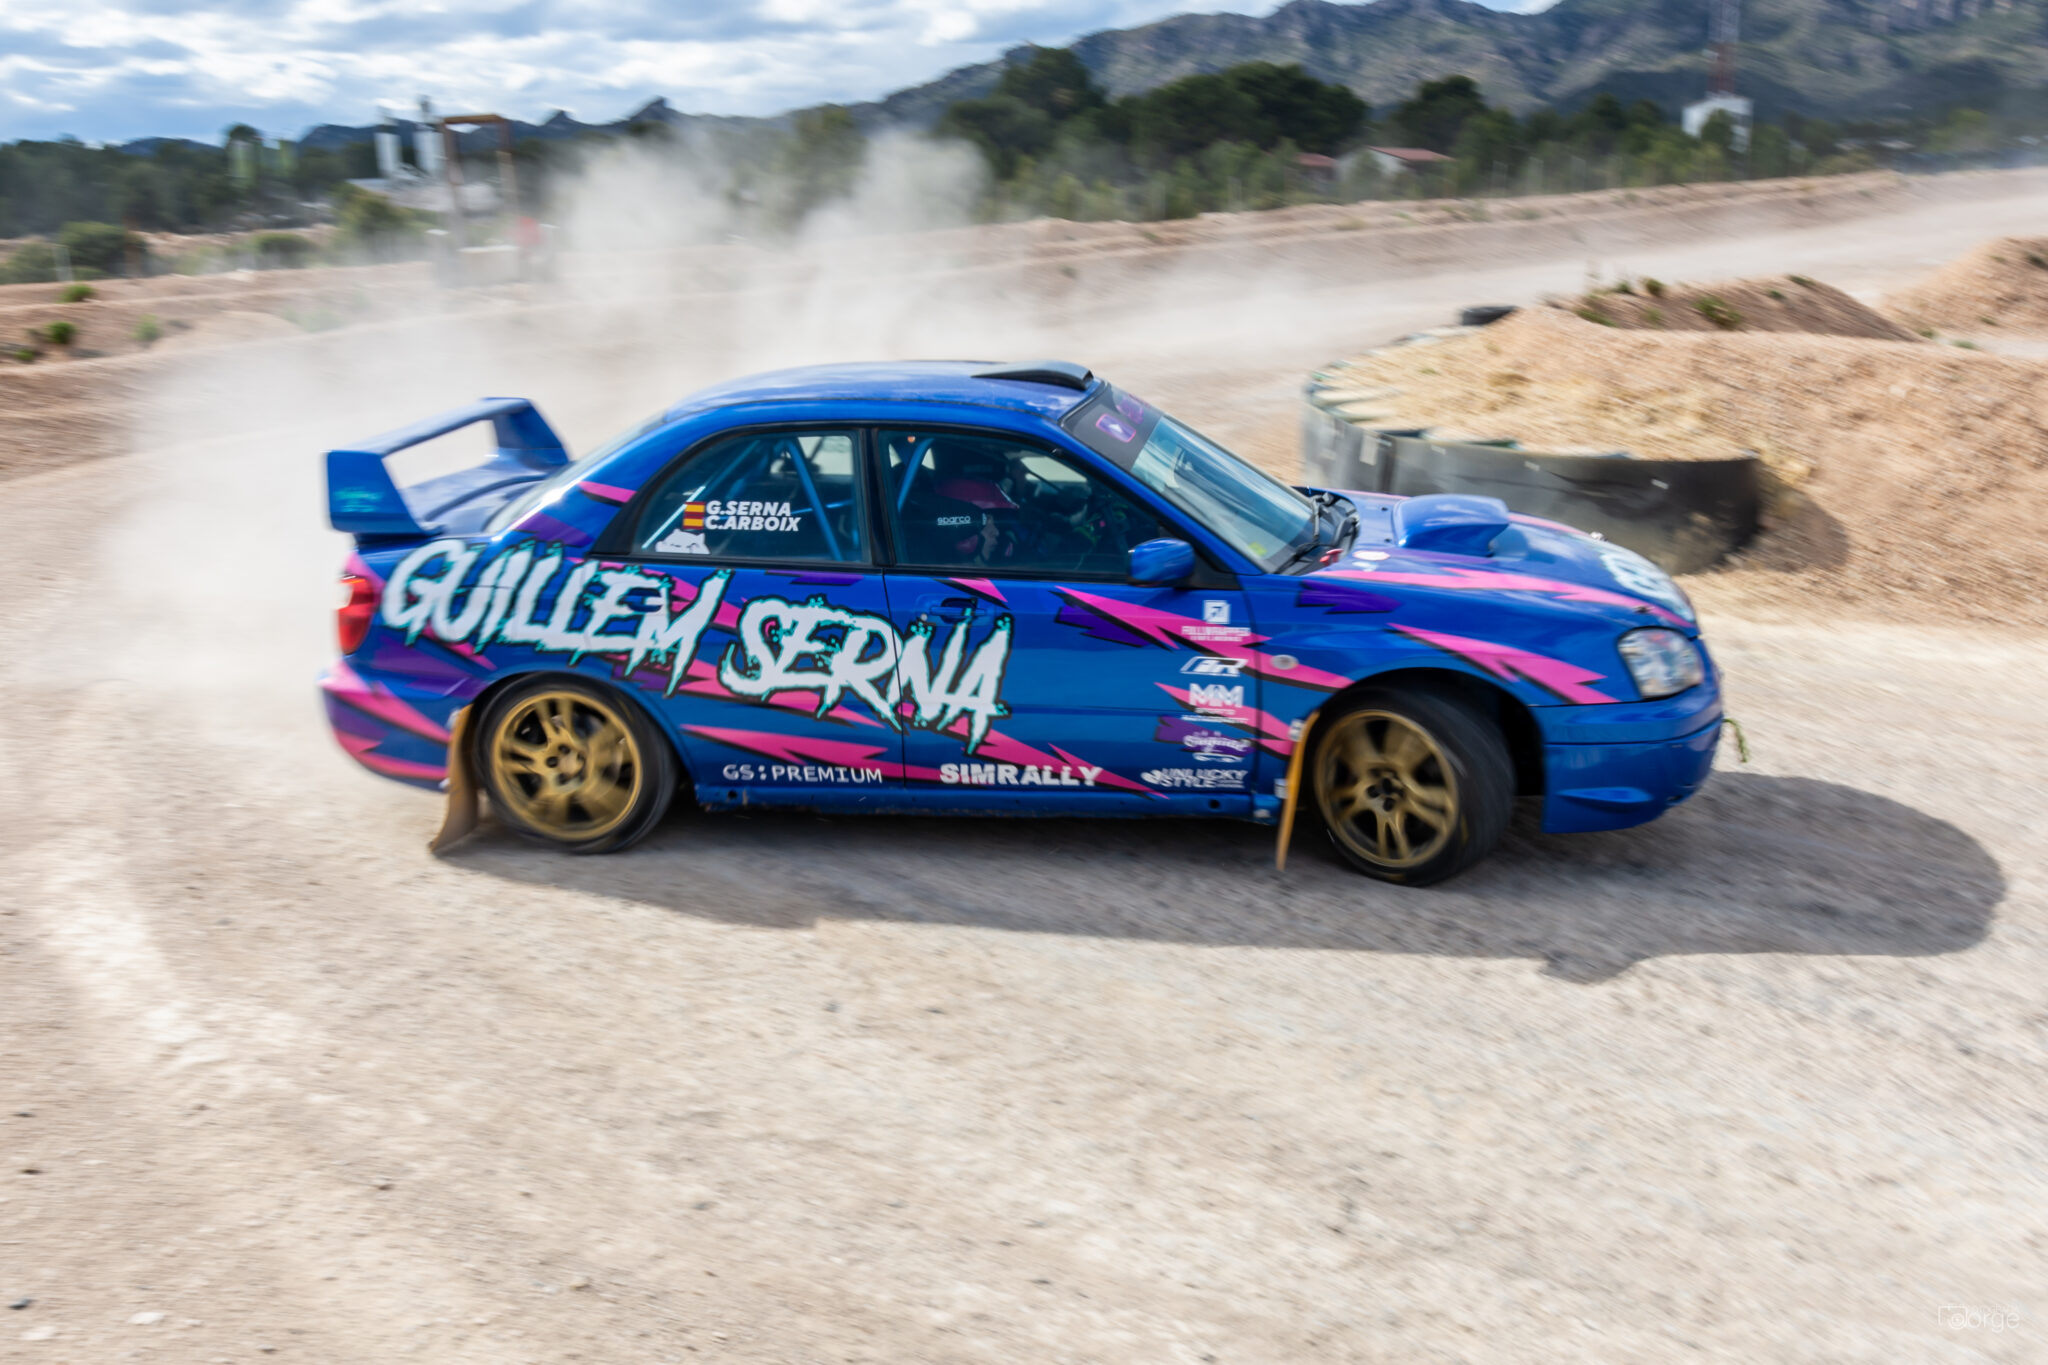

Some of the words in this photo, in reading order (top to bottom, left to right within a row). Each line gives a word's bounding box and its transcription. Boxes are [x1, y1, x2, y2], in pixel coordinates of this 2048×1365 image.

[706, 500, 792, 516] G.SERNA
[704, 515, 801, 531] C.ARBOIX
[937, 515, 971, 525] sparco
[381, 537, 732, 698] GUILLEM
[719, 595, 1012, 756] SERNA
[940, 763, 1103, 786] SIMRALLY
